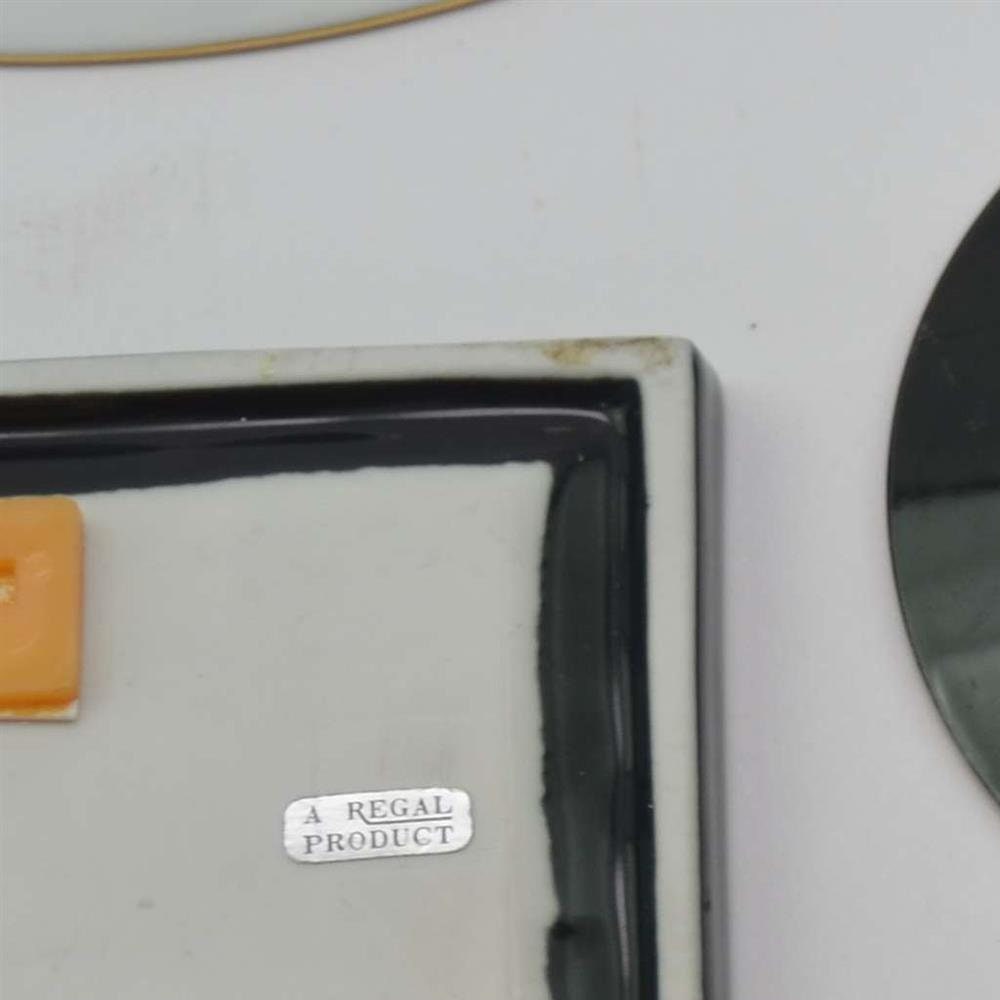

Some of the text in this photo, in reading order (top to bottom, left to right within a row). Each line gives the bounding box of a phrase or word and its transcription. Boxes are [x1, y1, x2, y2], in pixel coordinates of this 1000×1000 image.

[304, 795, 454, 825] A REGAL
[303, 825, 454, 855] PRODUCT
